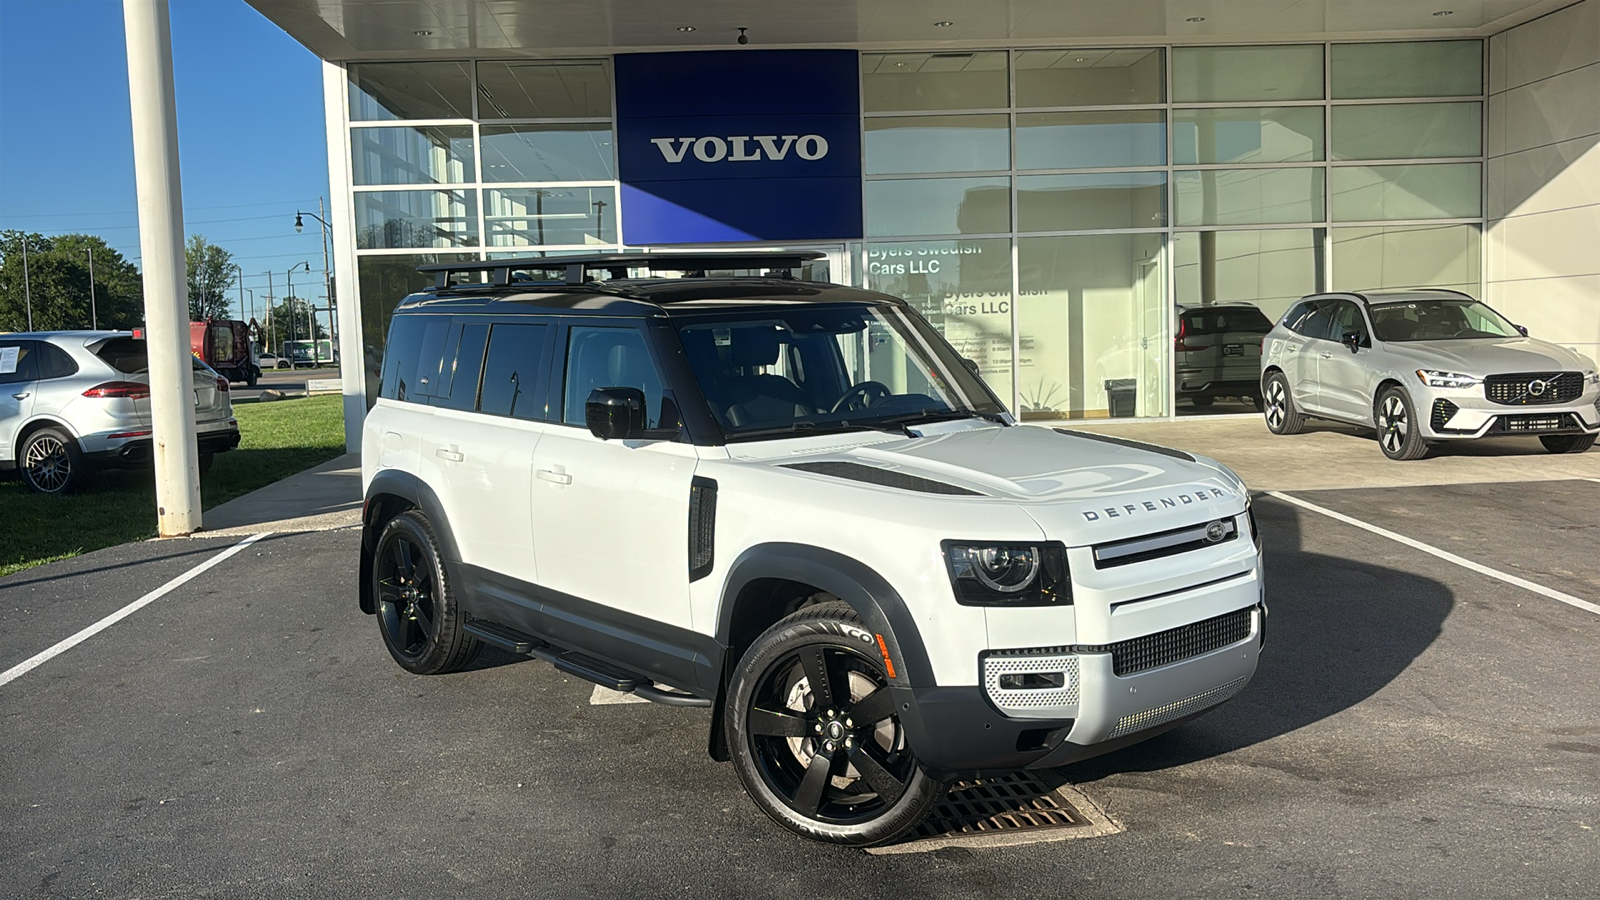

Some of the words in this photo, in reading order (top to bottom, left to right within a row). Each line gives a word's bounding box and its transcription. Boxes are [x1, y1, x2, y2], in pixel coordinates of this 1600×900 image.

[651, 134, 829, 163] VOLVO
[869, 246, 913, 260] Byers
[869, 262, 905, 275] Cars
[910, 260, 940, 274] LLC
[945, 302, 977, 316] Cars
[981, 301, 1009, 314] LLC
[1082, 488, 1224, 521] DEFENDER
[879, 797, 920, 836] Continental
